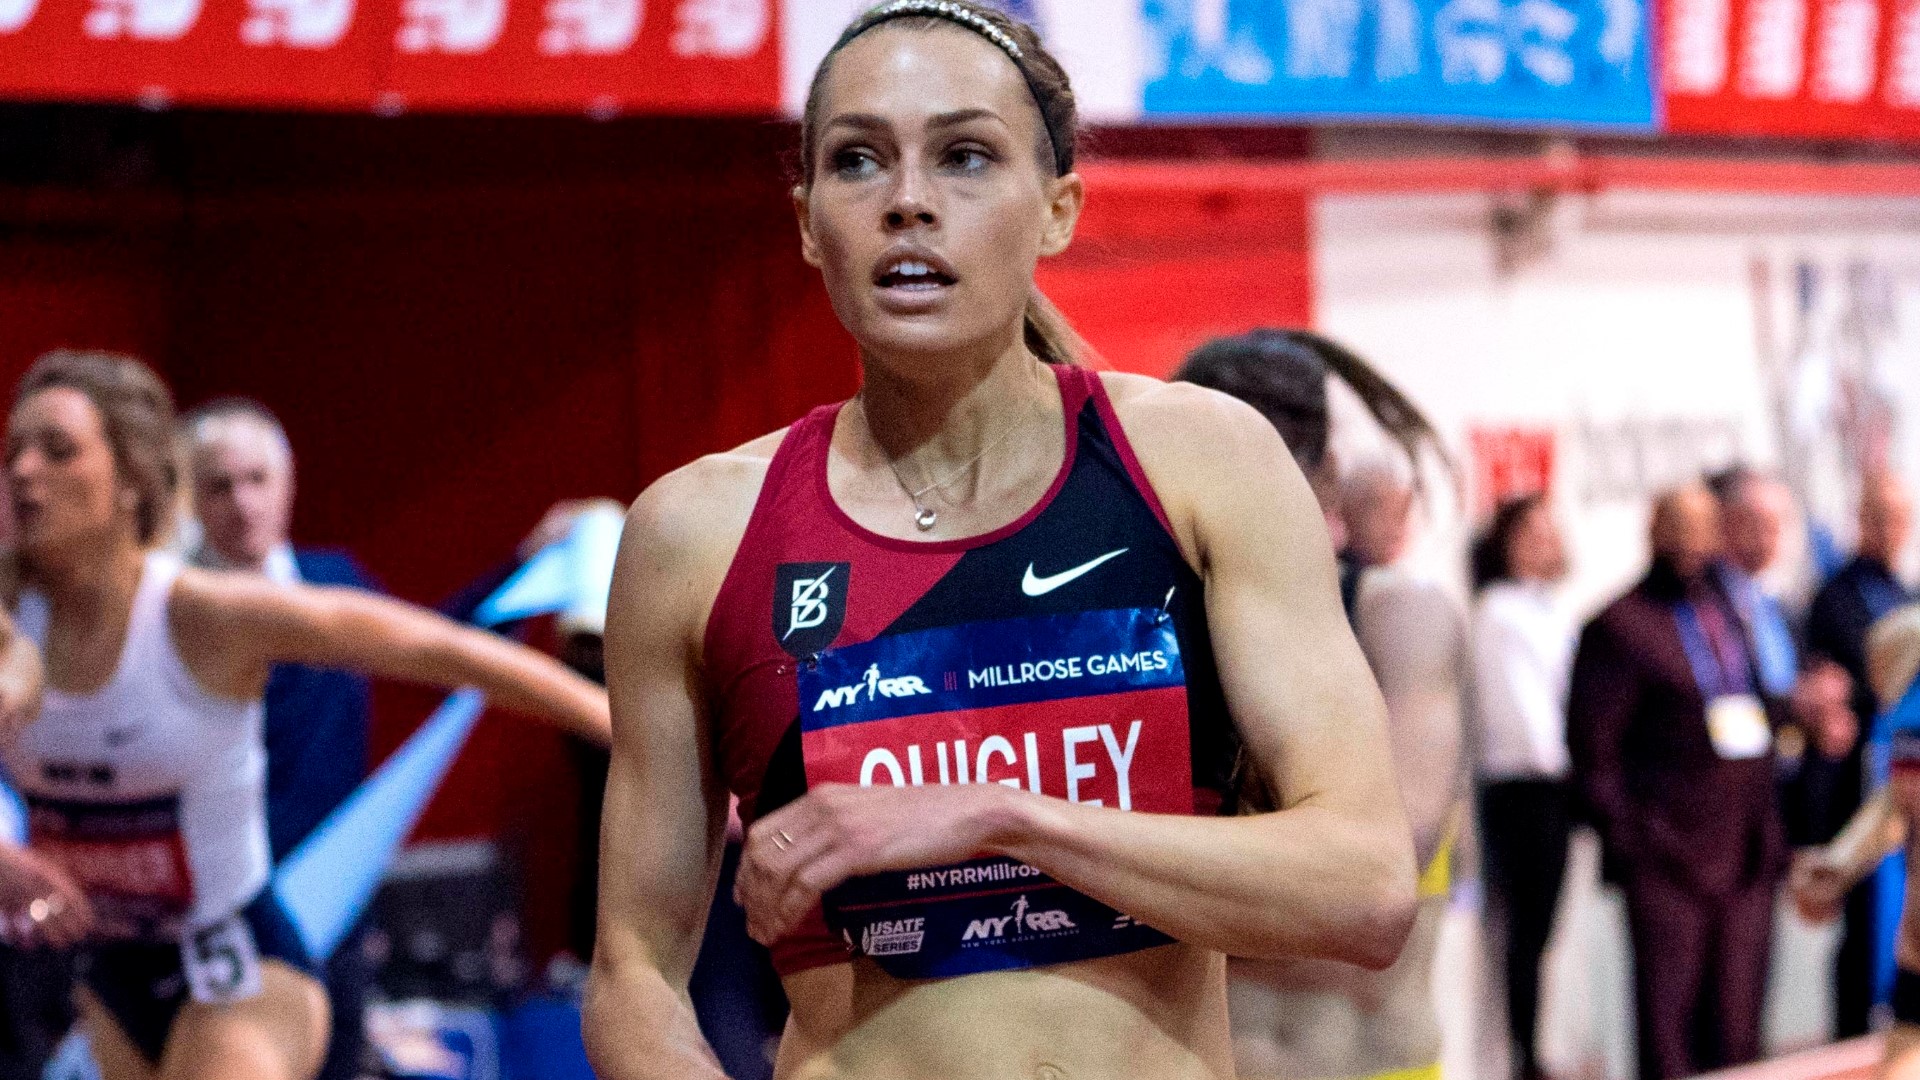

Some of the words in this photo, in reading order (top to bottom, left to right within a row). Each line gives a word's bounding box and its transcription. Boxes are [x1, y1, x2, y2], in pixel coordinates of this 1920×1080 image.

[968, 657, 1083, 689] MILLROSE
[1087, 650, 1168, 676] GAMES
[870, 917, 925, 935] USATF
[873, 940, 919, 954] SERIES
